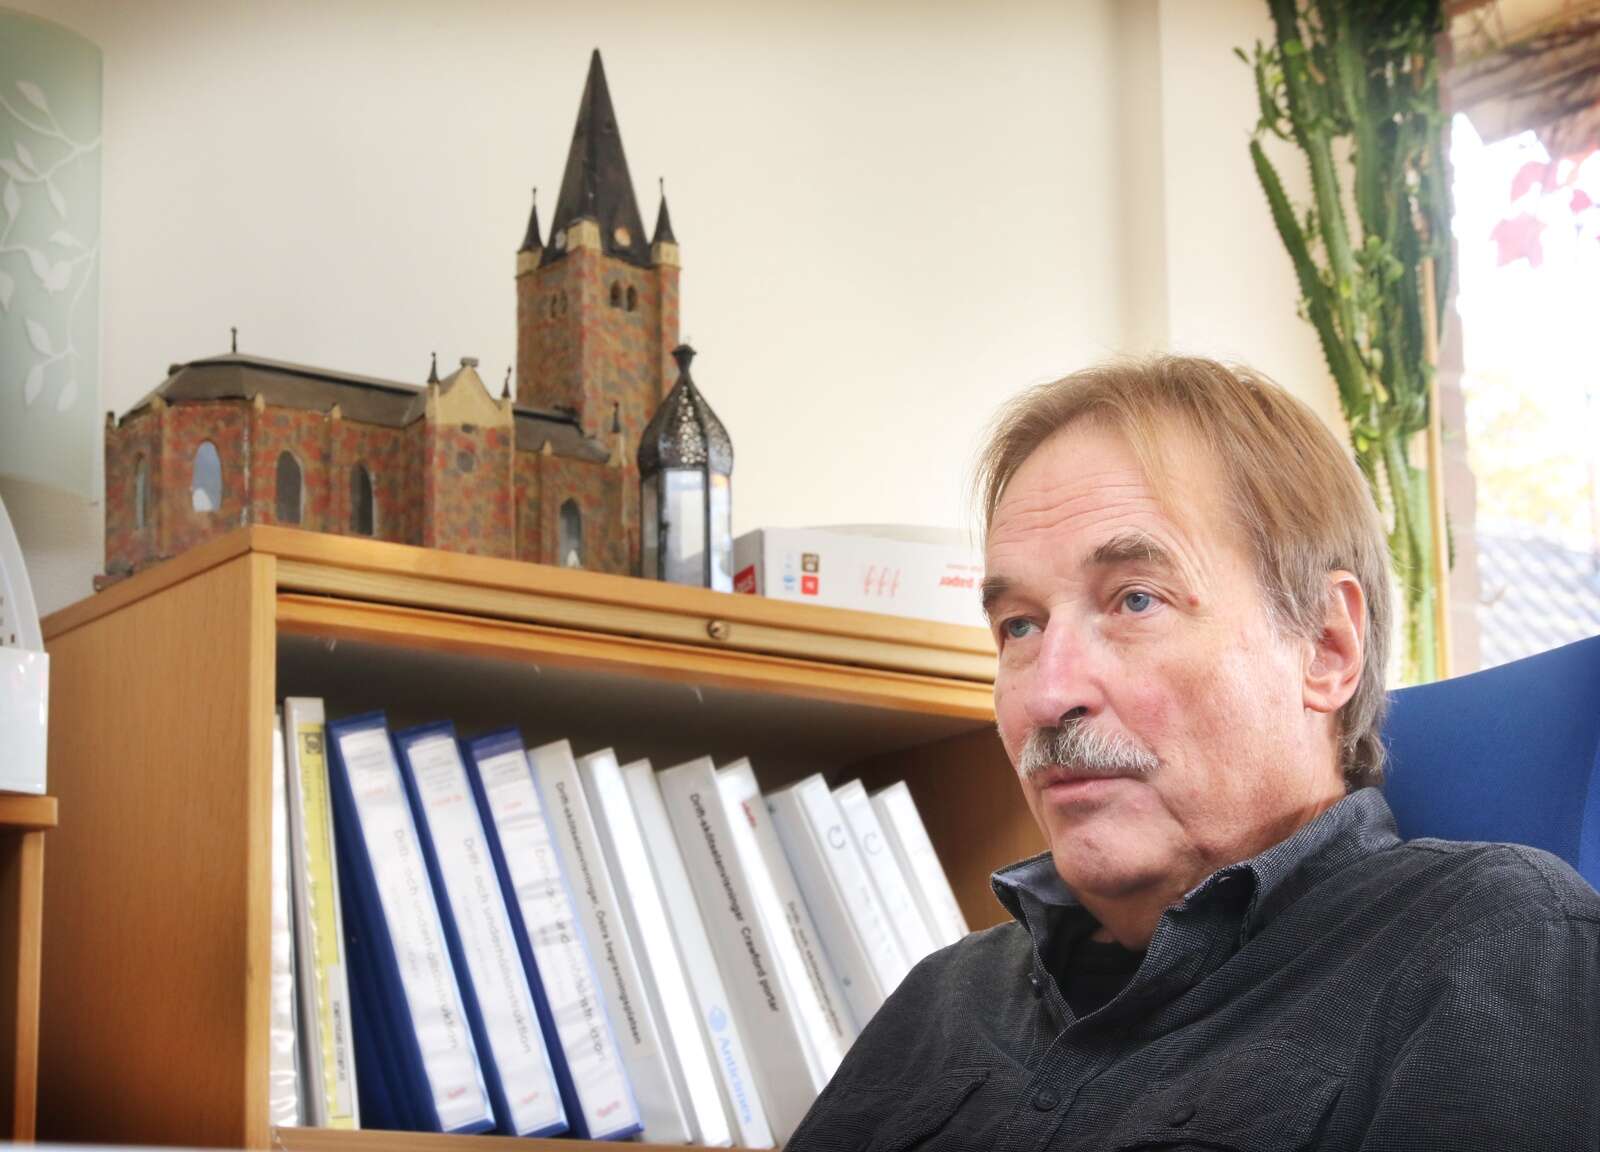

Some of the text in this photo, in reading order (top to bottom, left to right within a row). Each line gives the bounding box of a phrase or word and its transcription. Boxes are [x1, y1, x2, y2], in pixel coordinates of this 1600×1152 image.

[473, 873, 492, 903] och
[594, 908, 611, 939] Östra
[603, 941, 643, 1045] begravningsplatsen
[739, 925, 768, 977] Crawford
[758, 977, 781, 1013] portar
